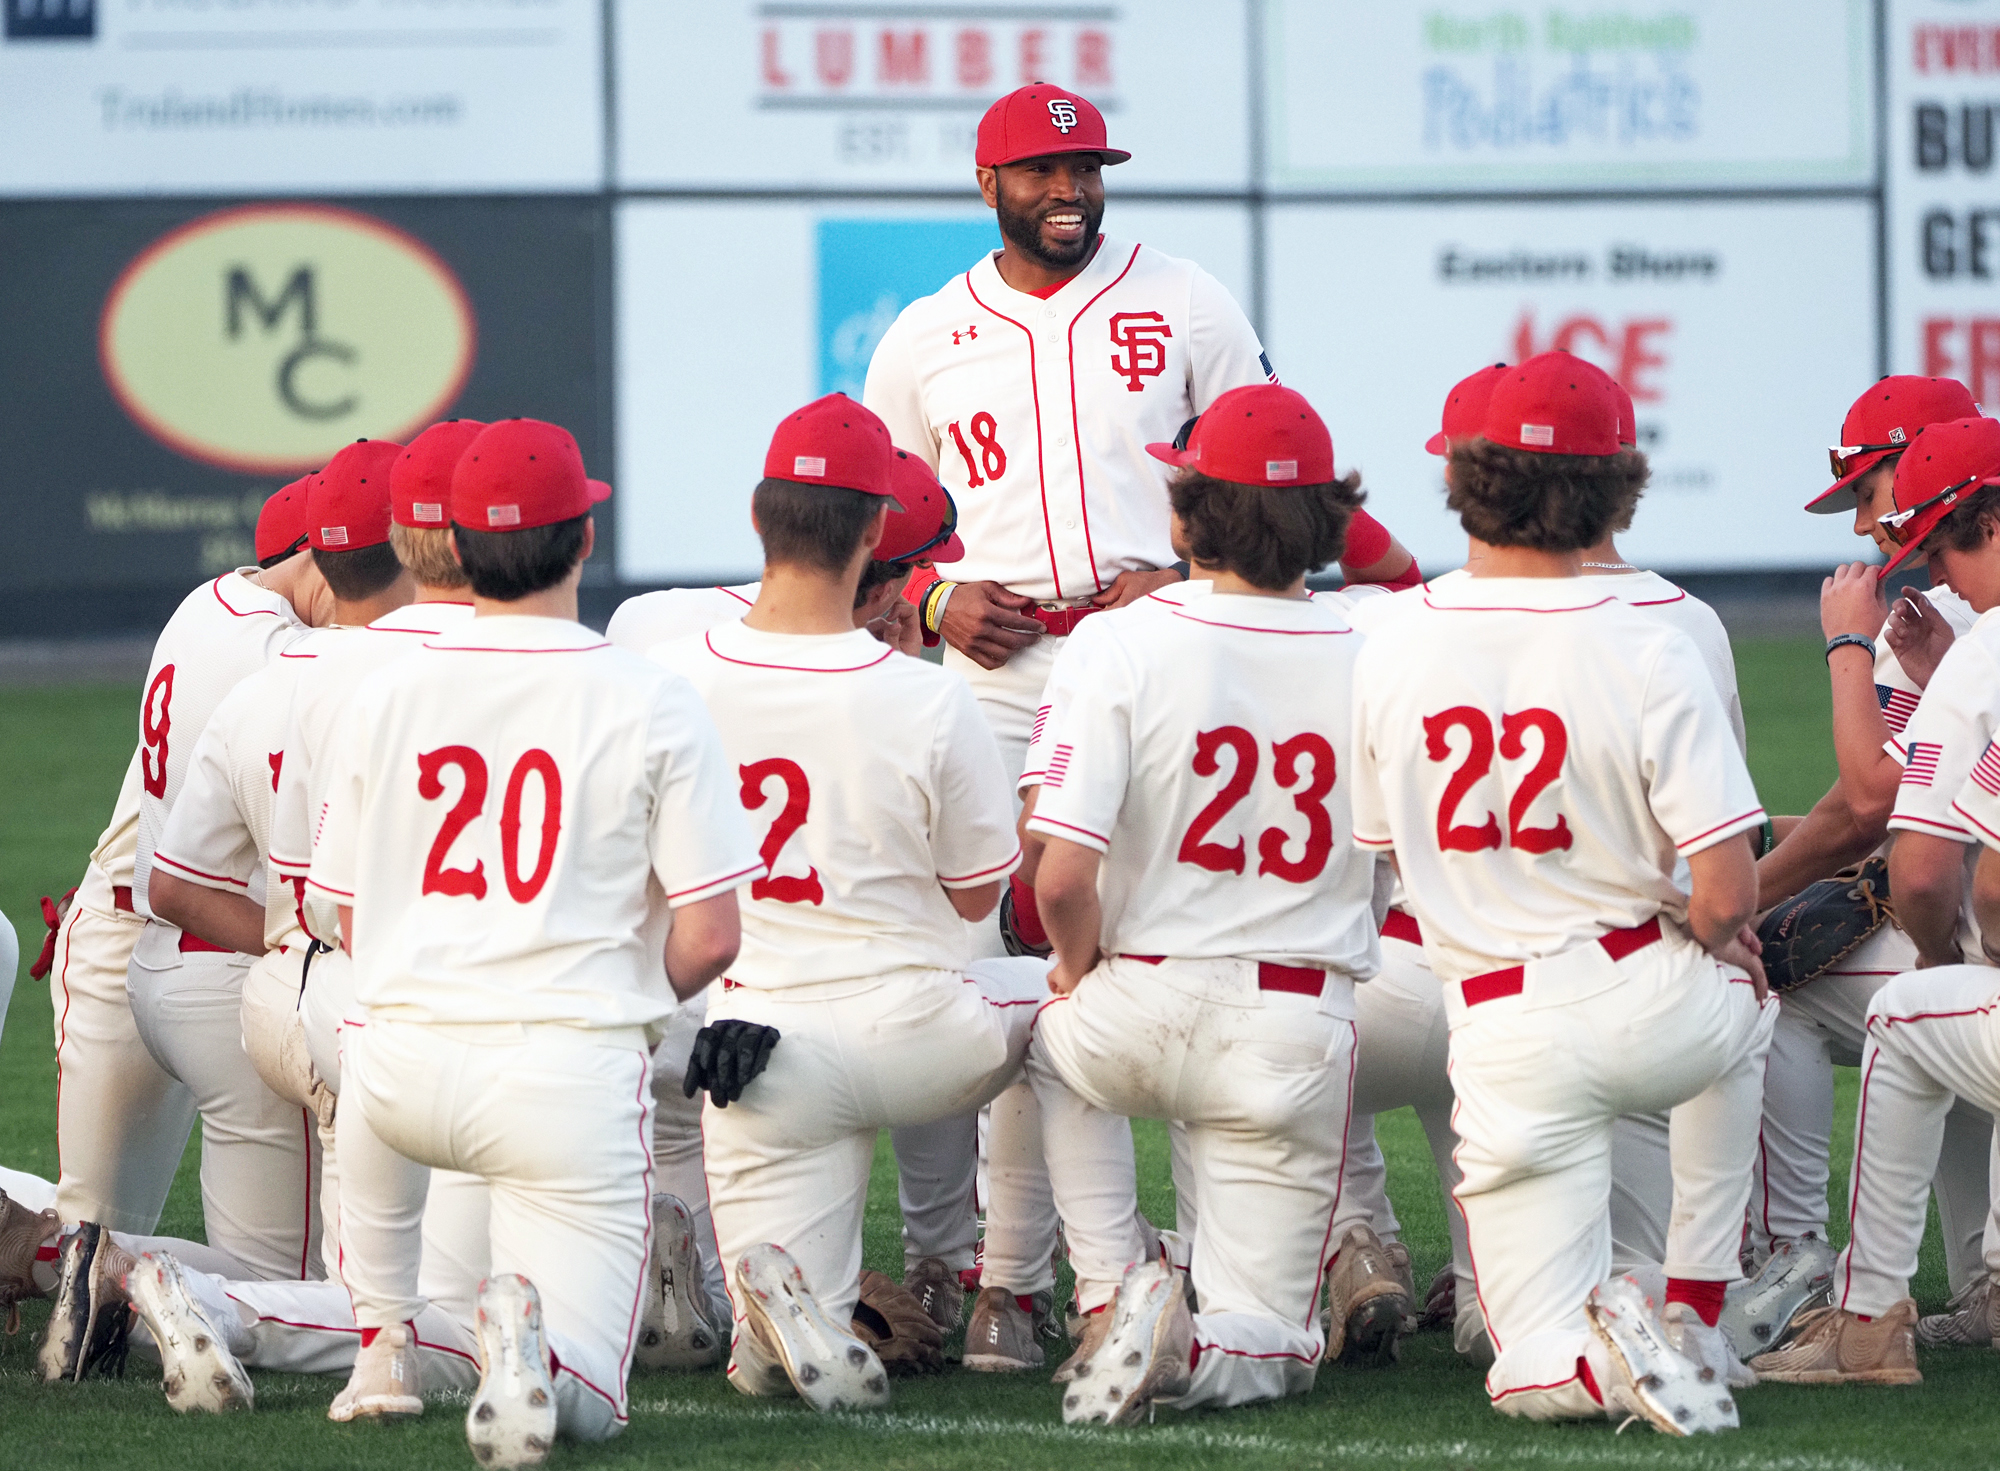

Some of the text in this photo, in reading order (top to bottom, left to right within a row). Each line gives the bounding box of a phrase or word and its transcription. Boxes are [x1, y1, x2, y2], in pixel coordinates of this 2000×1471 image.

[760, 26, 1114, 90] LUMBER
[1915, 103, 2000, 173] BU
[1109, 311, 1173, 392] SF
[948, 411, 1007, 488] 18
[142, 664, 175, 799] 9
[1422, 706, 1573, 854] 22
[417, 745, 562, 904] 20
[739, 757, 824, 905] 2
[1178, 725, 1337, 883] 23
[1778, 901, 1808, 938] A2000
